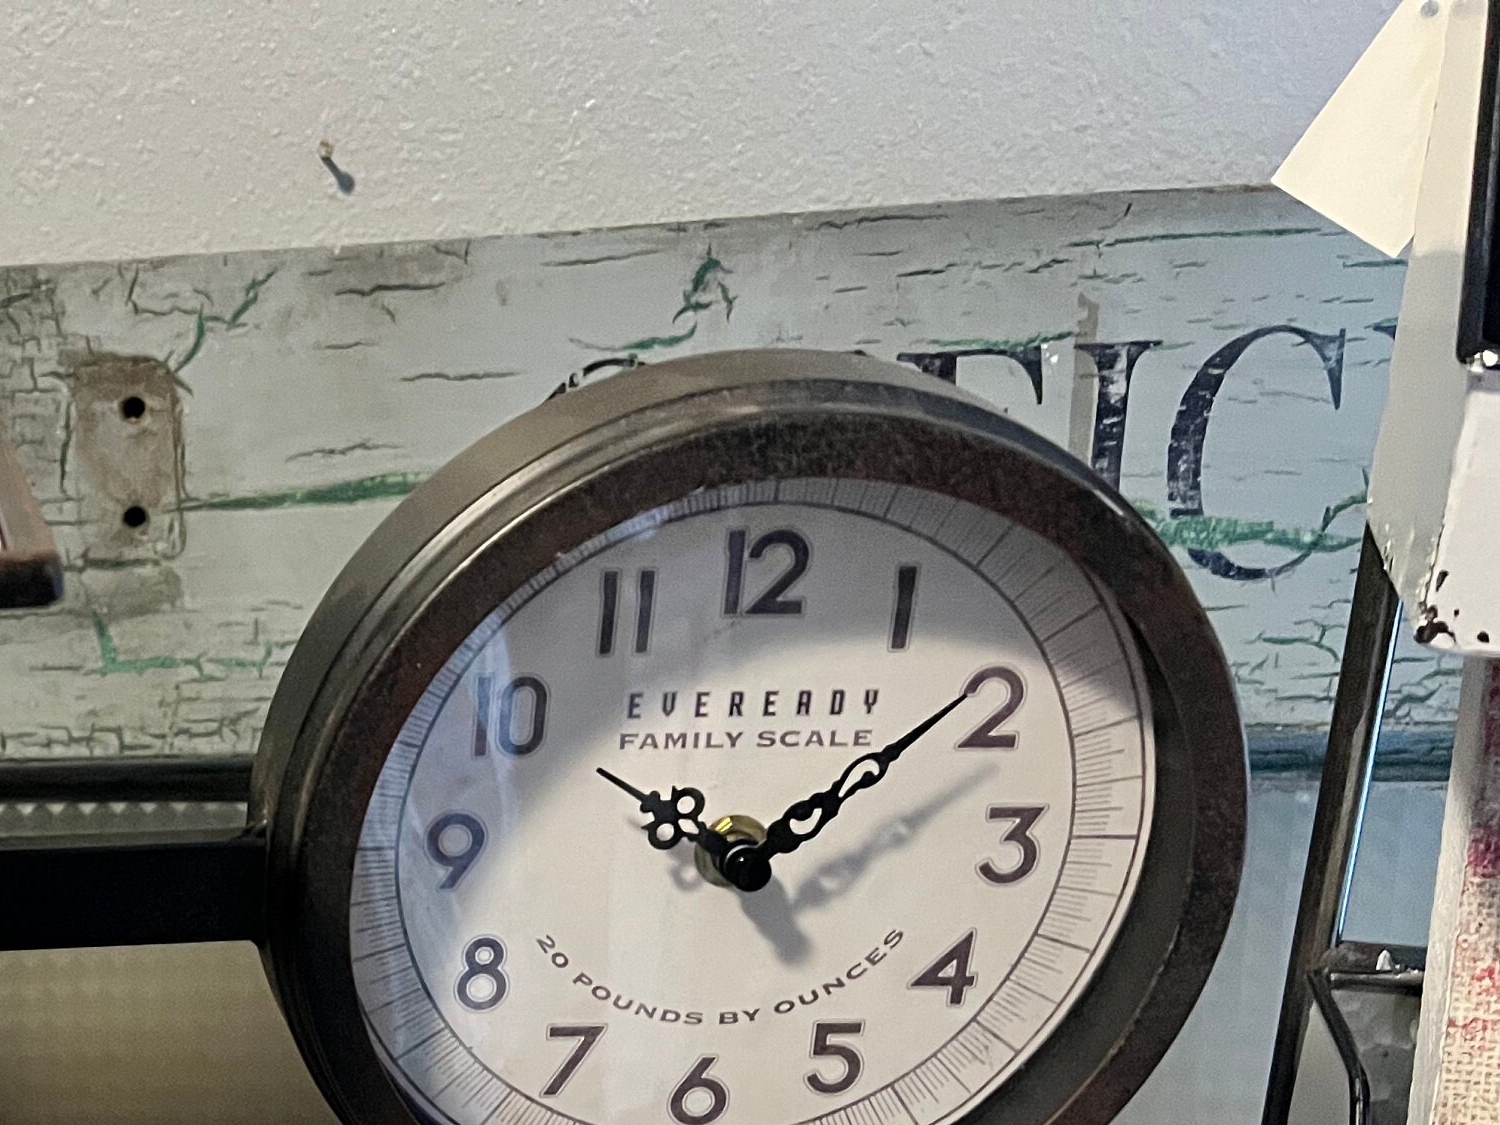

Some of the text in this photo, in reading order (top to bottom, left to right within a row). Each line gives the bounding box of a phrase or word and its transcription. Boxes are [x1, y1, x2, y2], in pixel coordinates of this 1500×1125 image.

[723, 529, 810, 616] 12
[890, 564, 919, 650] 1
[597, 569, 656, 658] 11
[473, 675, 548, 758] 10
[618, 729, 873, 750] FAMILY SCALE
[626, 688, 880, 720] EVEREADY
[958, 667, 1025, 750] 2
[426, 812, 485, 890] 9
[977, 806, 1046, 885] 3
[456, 937, 507, 1009] 8
[535, 928, 905, 1026] 20 POUNDS BY OUNCES
[908, 929, 976, 1006] 4
[543, 1025, 605, 1096] 7
[805, 1021, 864, 1095] 5
